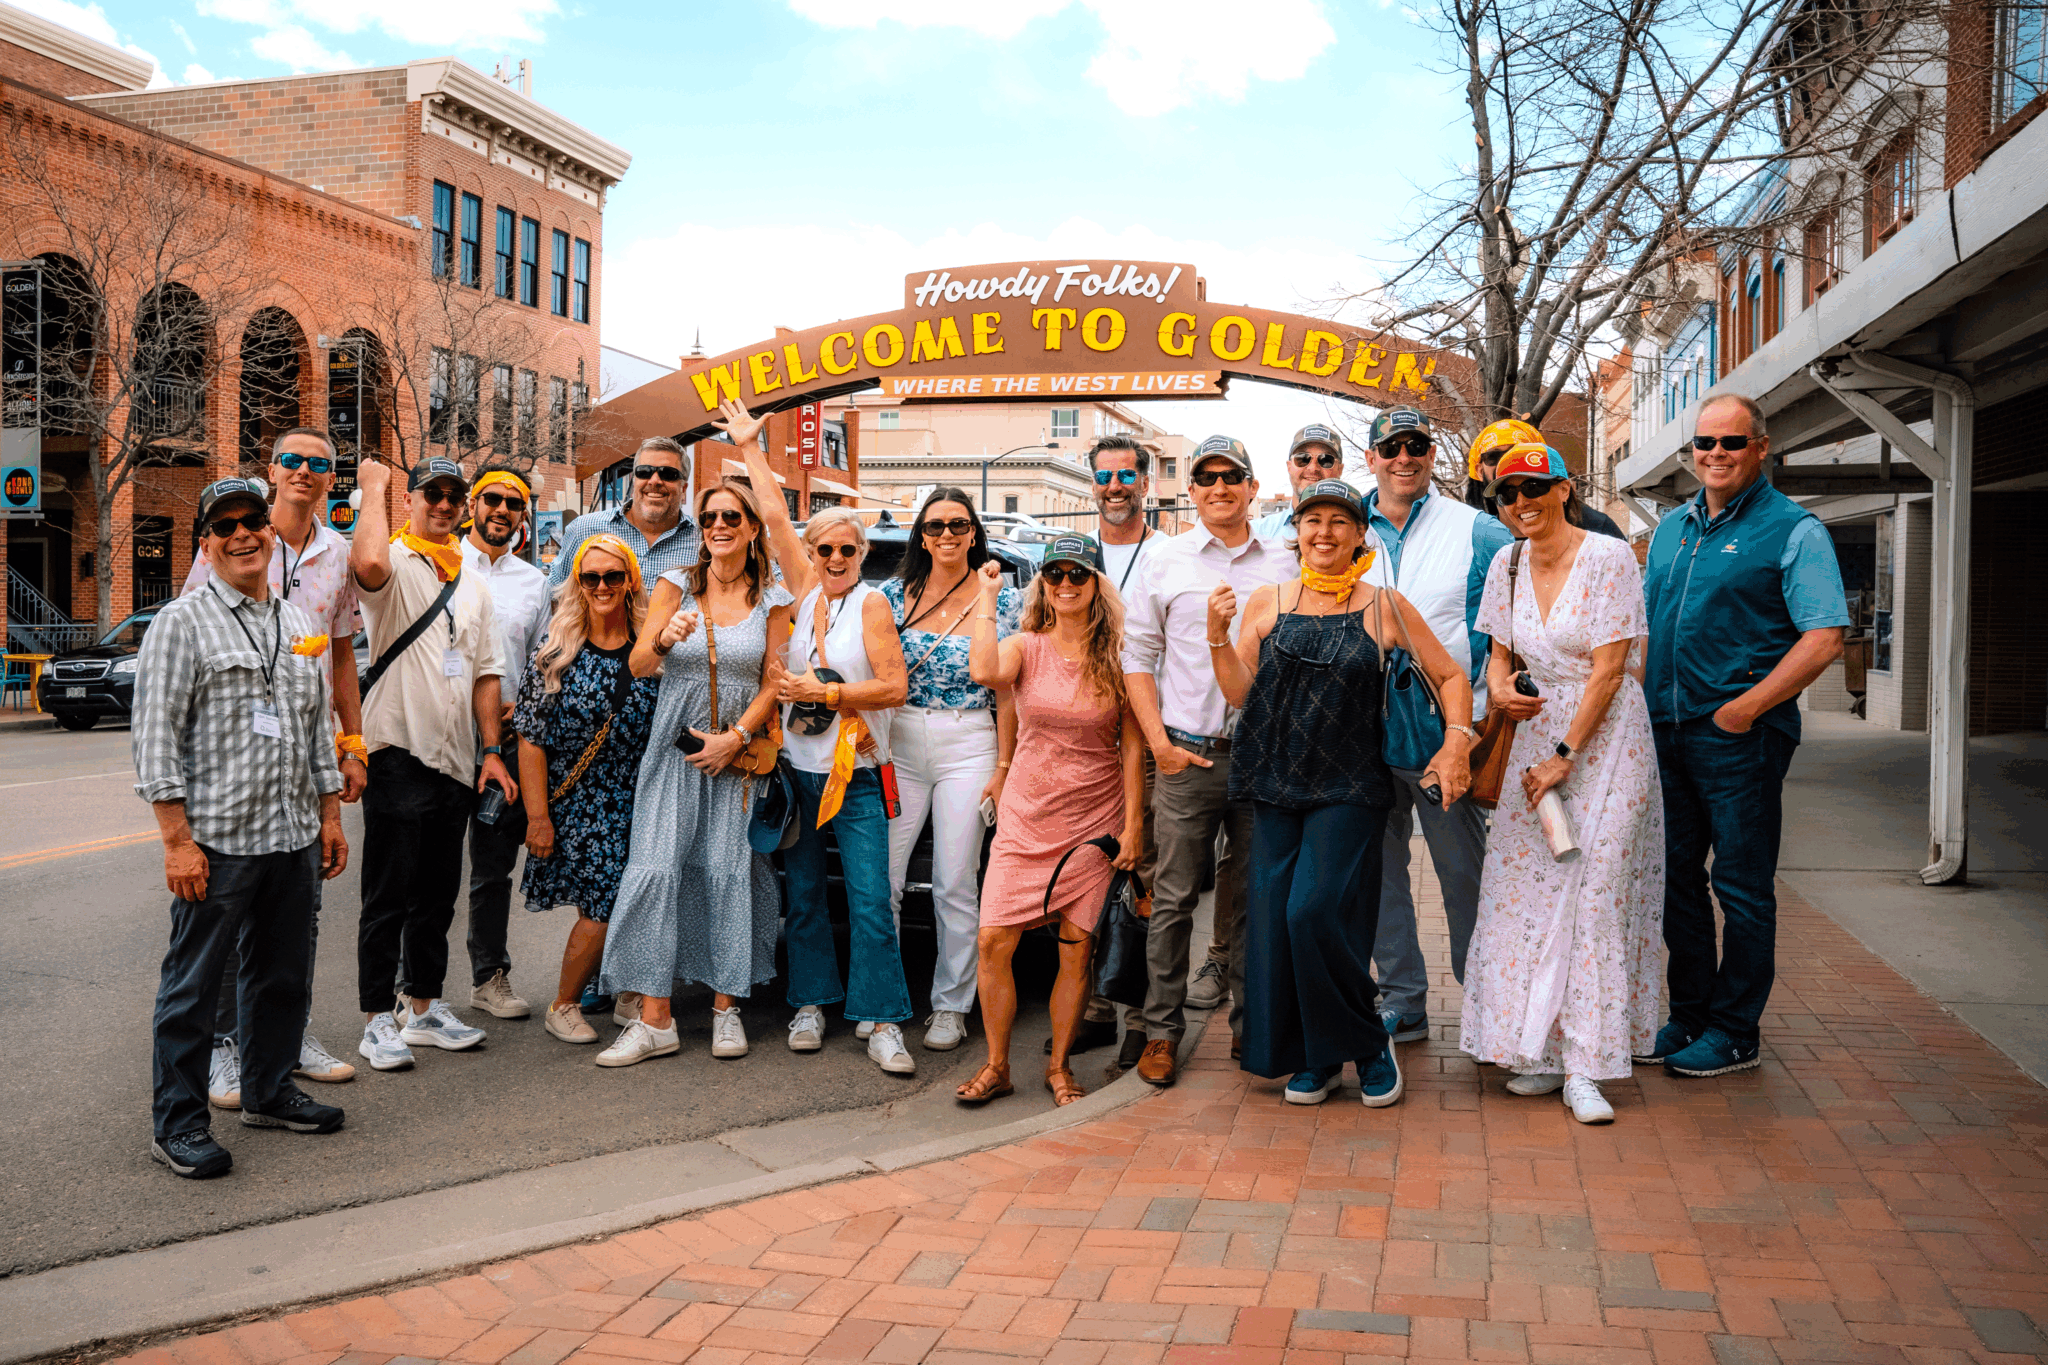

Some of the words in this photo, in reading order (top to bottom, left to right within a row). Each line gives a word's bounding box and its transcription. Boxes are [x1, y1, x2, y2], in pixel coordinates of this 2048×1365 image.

[5, 283, 35, 293] GOLDEN
[914, 265, 1050, 308] Howdy
[1053, 264, 1182, 304] Folks!
[690, 311, 1005, 413] WELCOME
[1031, 307, 1126, 352] TO
[1157, 311, 1437, 401] GOLDEN
[893, 378, 982, 395] WHERE
[991, 377, 1041, 393] THE
[1051, 376, 1124, 392] WEST
[1131, 374, 1206, 391] LIVES
[801, 404, 816, 465] ROSE
[1203, 441, 1227, 450] COMPASS
[12, 476, 33, 487] KONA
[217, 482, 245, 490] COMPASS
[137, 544, 165, 558] GOLD
